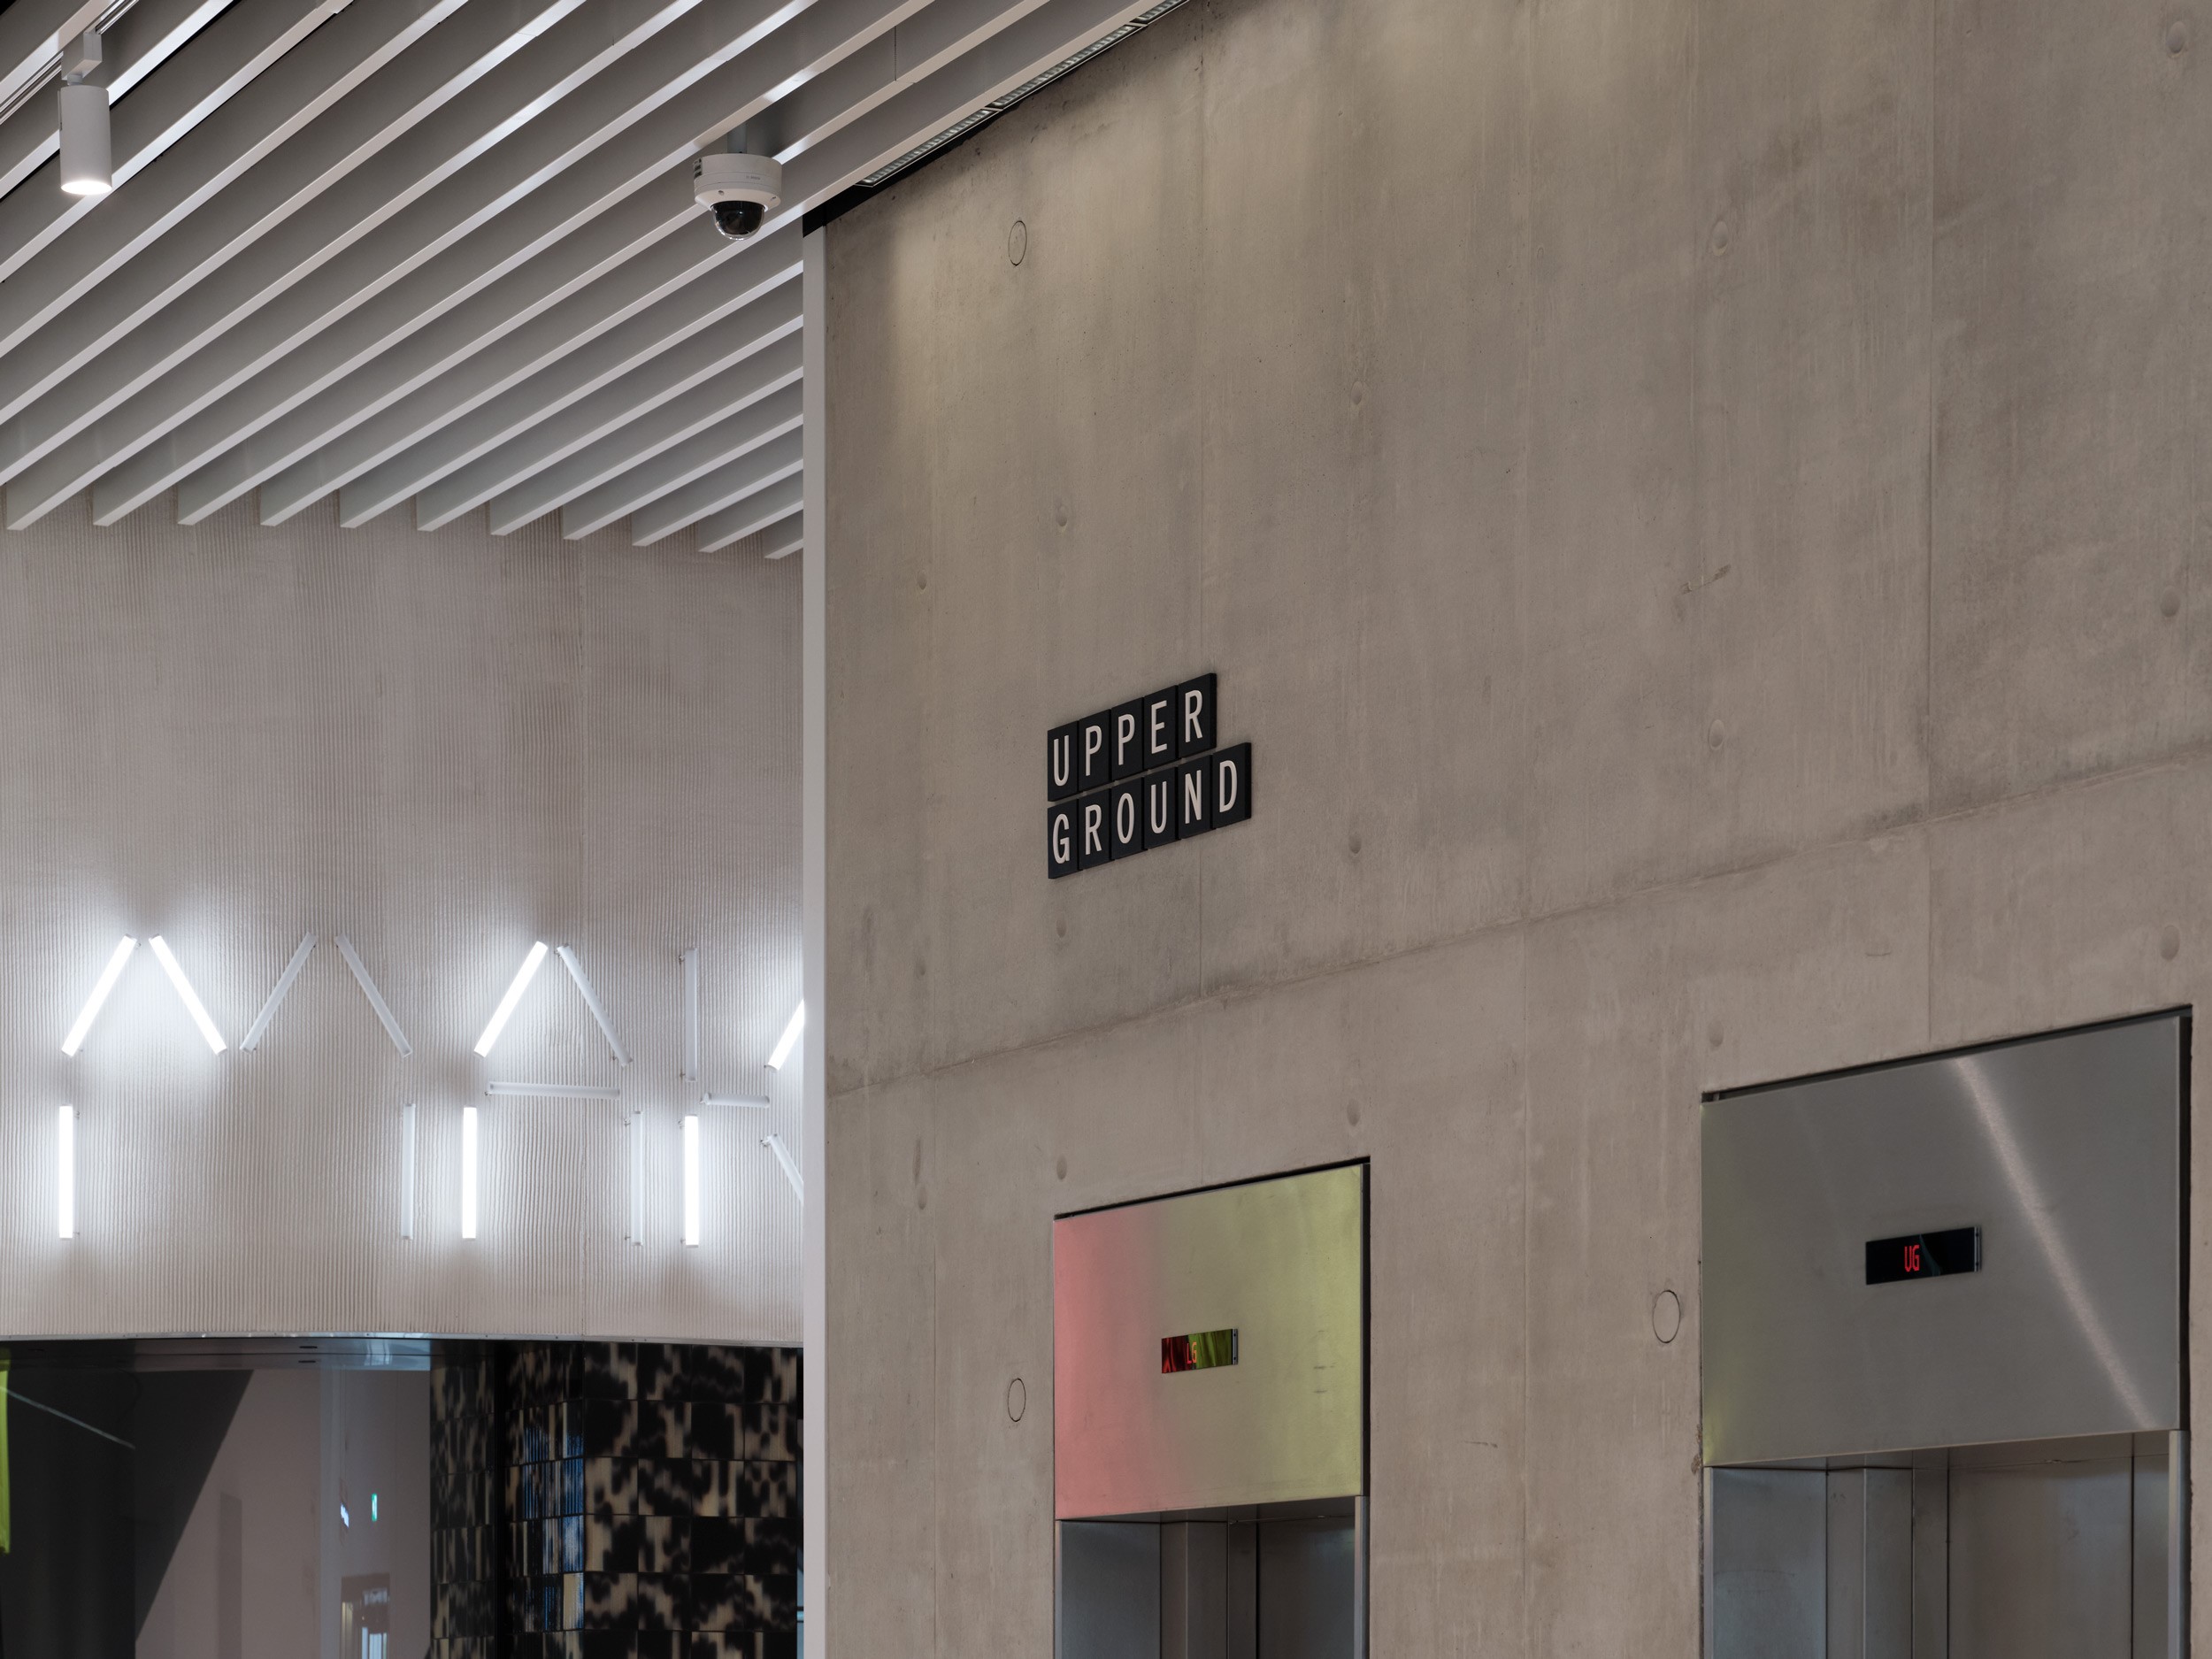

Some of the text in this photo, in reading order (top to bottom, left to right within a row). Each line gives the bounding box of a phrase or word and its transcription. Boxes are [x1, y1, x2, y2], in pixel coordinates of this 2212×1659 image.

[1053, 689, 1203, 787] UPPER
[1052, 759, 1238, 864] GROUND
[1903, 1244, 1920, 1272] UG
[1187, 1341, 1197, 1364] LG
